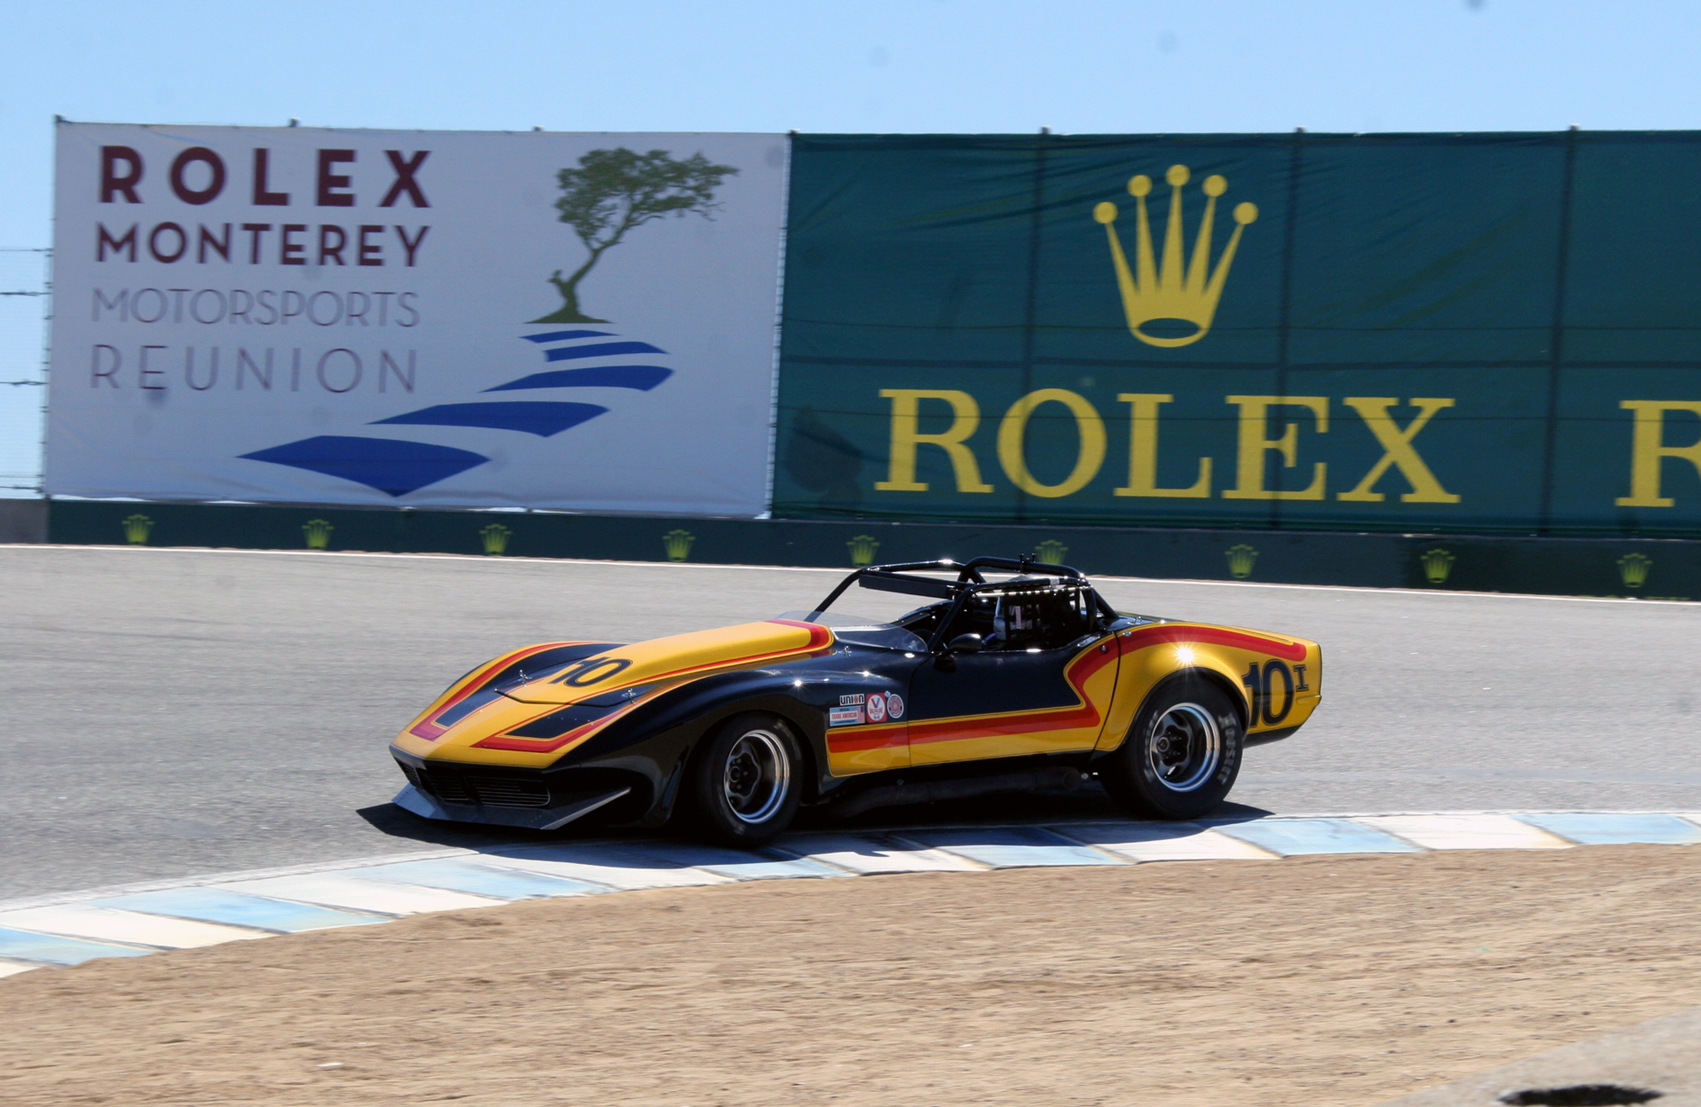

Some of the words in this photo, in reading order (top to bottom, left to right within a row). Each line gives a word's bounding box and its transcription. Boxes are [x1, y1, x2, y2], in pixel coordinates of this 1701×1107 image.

[100, 145, 432, 208] ROLEX
[95, 222, 431, 267] MONTEREY
[92, 288, 420, 328] MOTORSPORTS
[91, 344, 417, 394] REUNION
[874, 388, 1461, 504] ROLEX
[547, 656, 633, 688] 10
[1241, 658, 1294, 728] 10
